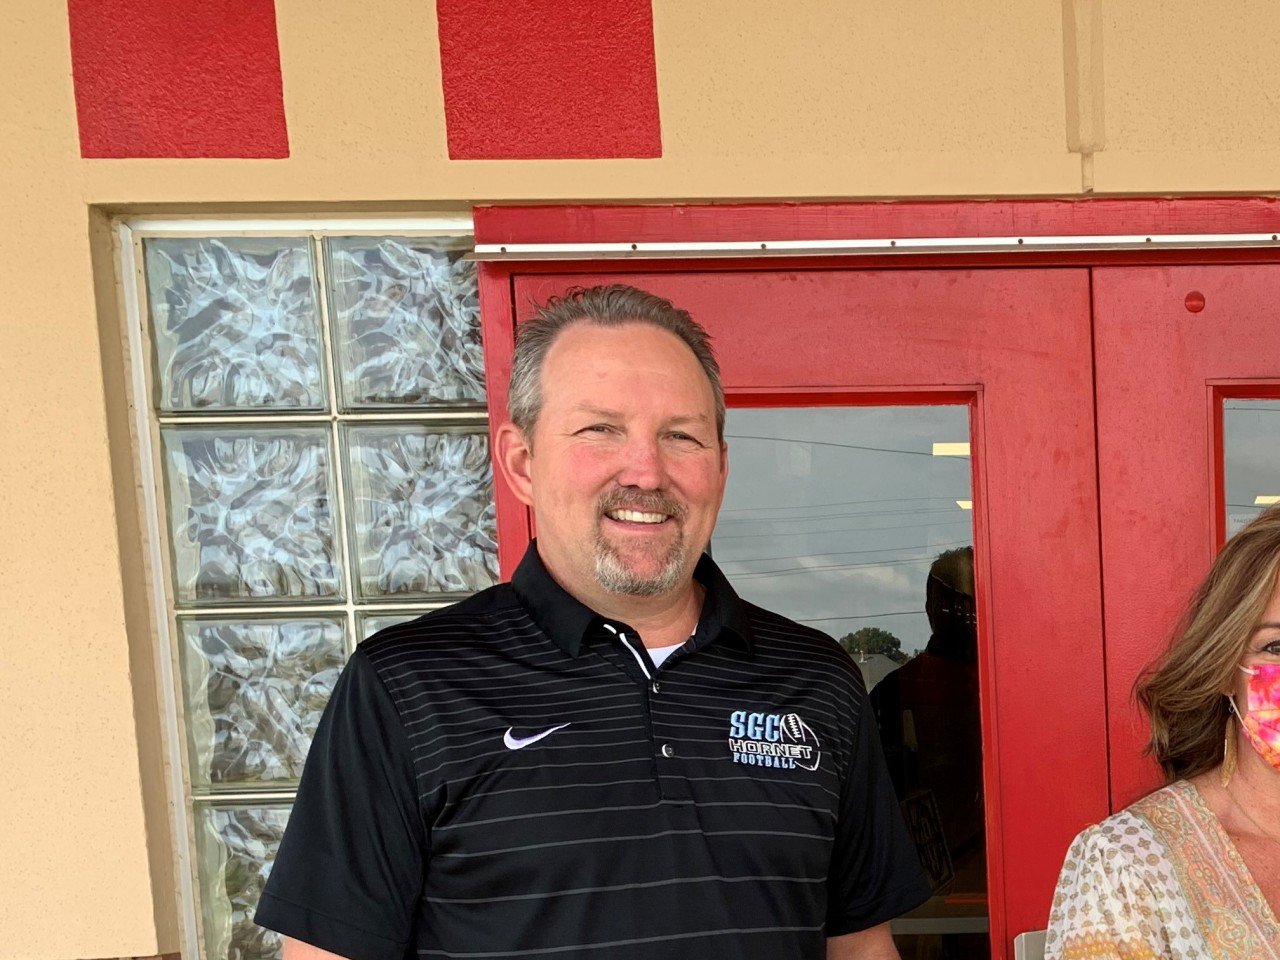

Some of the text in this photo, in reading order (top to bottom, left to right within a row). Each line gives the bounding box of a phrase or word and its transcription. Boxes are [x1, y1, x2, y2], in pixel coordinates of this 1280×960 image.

[729, 711, 780, 742] SGC
[728, 738, 812, 759] HORNET
[733, 752, 796, 769] FOOTBALL
